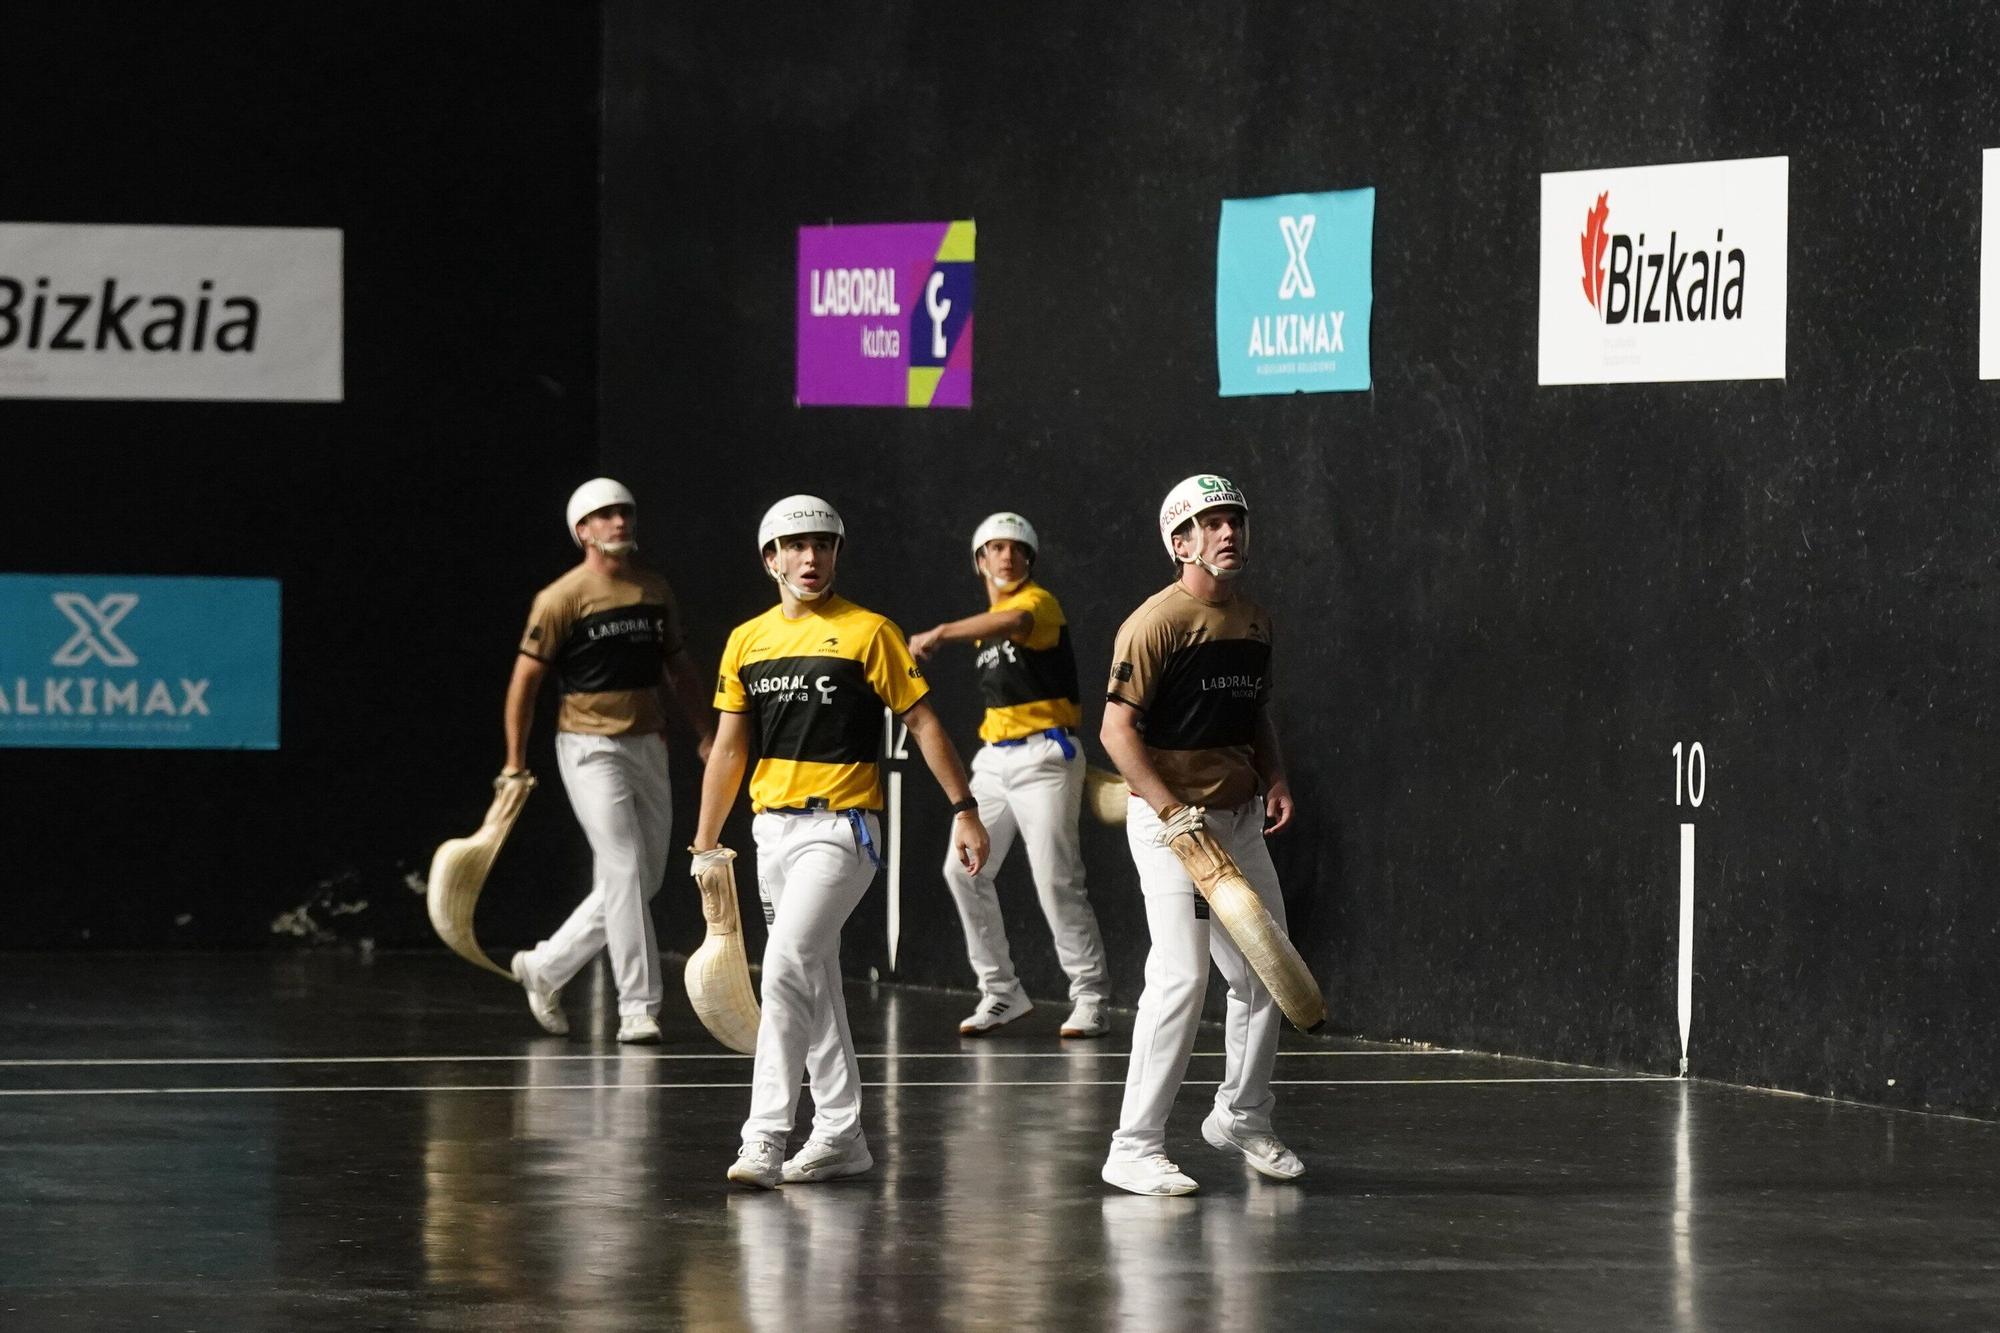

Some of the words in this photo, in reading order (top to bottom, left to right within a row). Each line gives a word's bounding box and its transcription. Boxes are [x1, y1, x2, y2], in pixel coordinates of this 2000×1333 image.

[811, 268, 900, 317] LABORAL
[1606, 228, 1745, 324] Bizkaia
[861, 325, 900, 358] kutxa
[1248, 311, 1344, 358] ALKIMAX
[1202, 675, 1254, 691] LABORAL
[1672, 741, 1706, 808] 10
